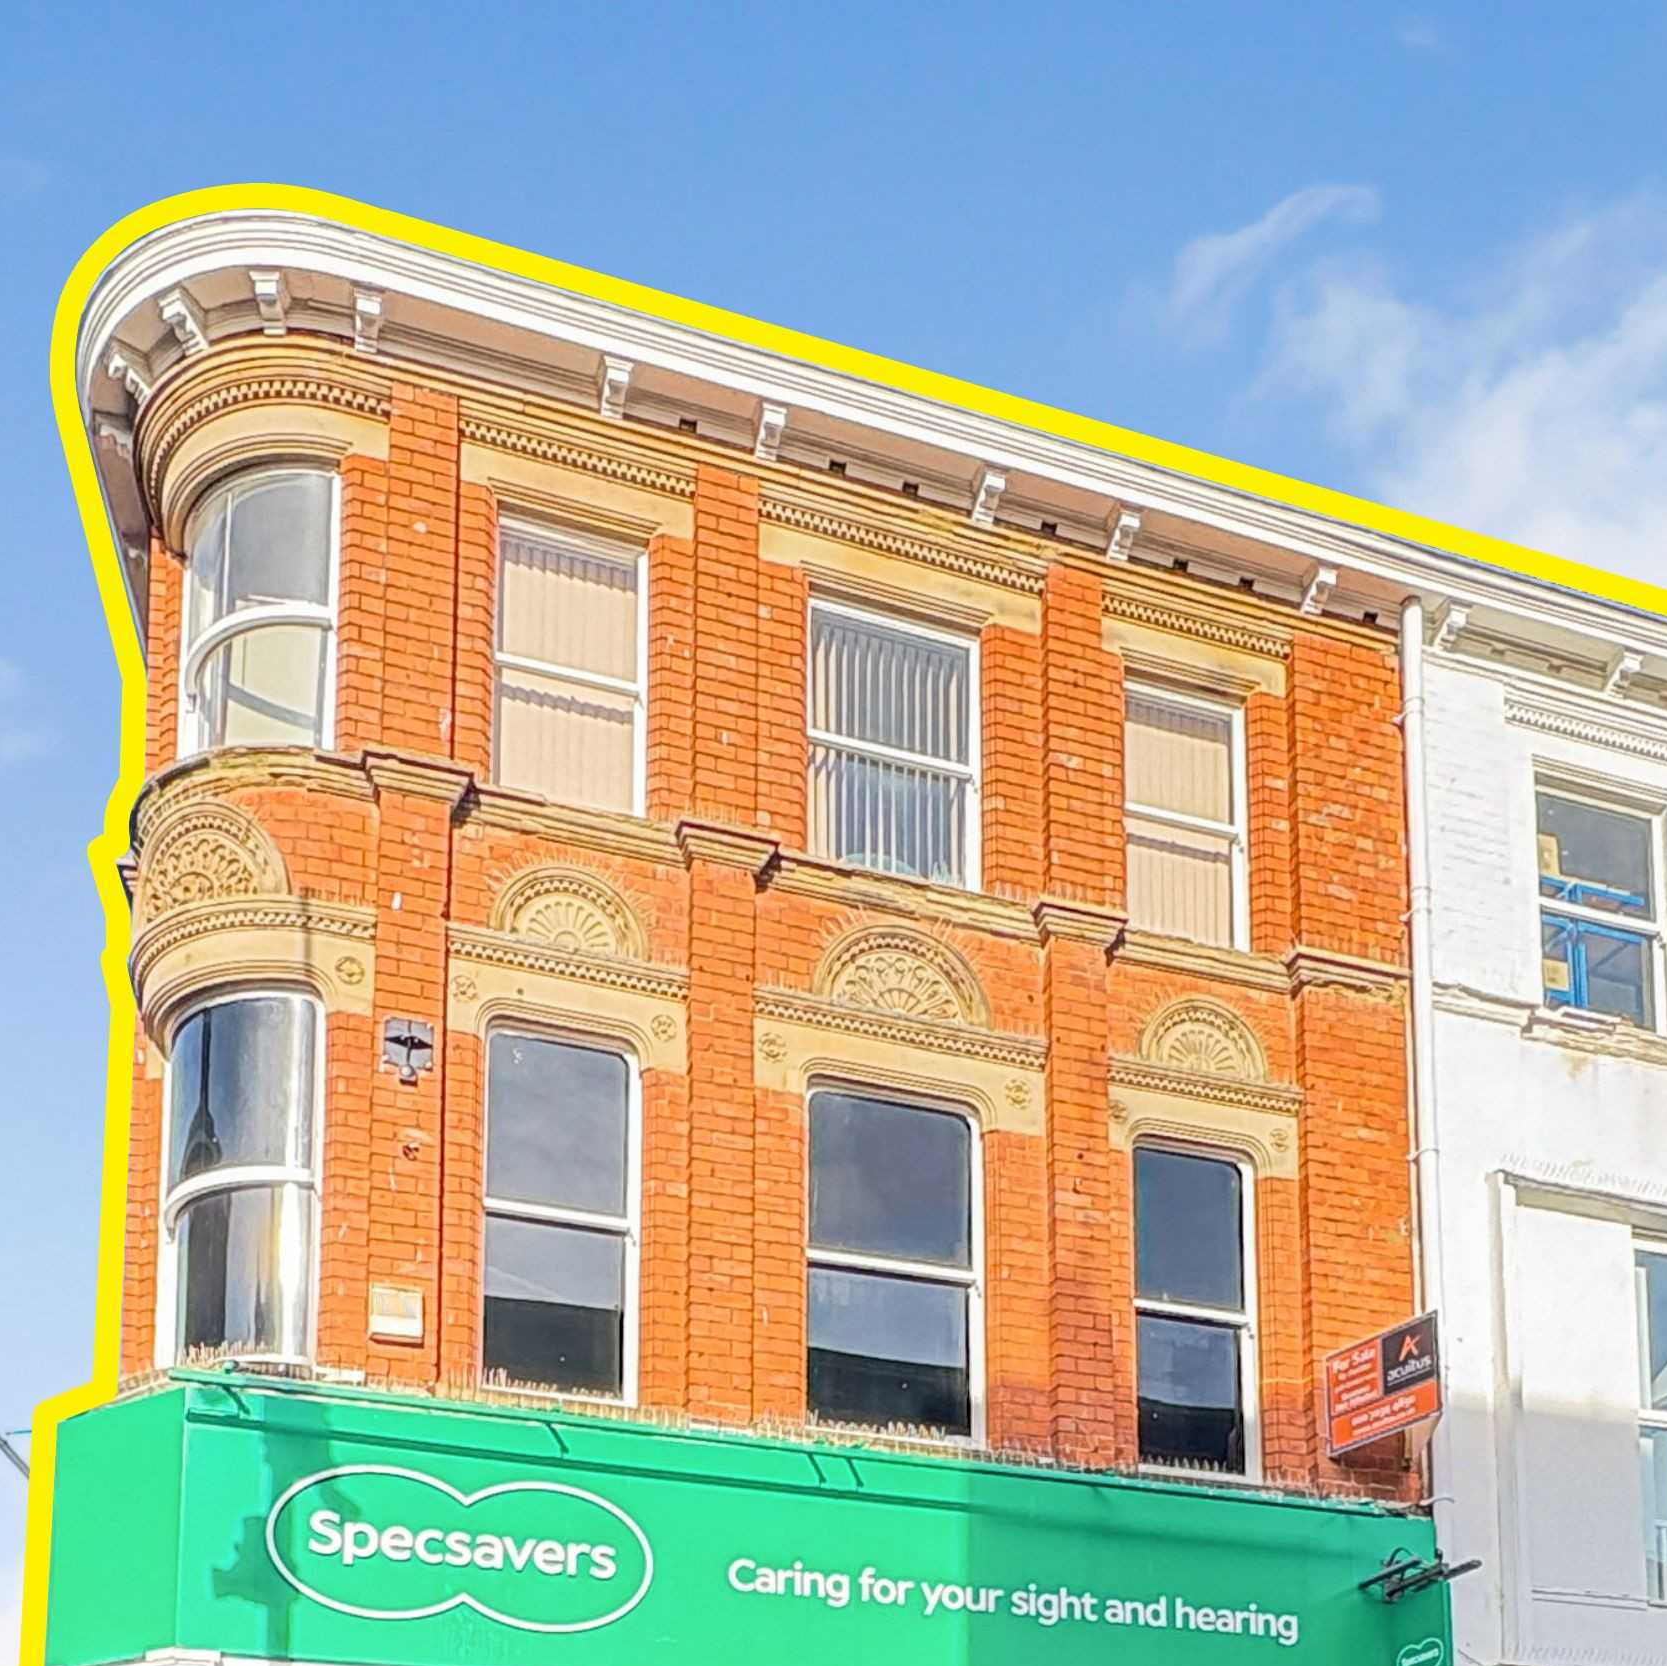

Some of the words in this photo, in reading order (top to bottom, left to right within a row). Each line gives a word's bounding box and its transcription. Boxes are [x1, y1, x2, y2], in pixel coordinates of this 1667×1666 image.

[307, 1509, 617, 1580] Specsavers
[727, 1558, 851, 1607] Caring
[857, 1566, 915, 1607] for
[920, 1578, 1005, 1616] your
[1010, 1583, 1099, 1627] sight
[1103, 1596, 1168, 1629] and
[1174, 1596, 1299, 1646] hearing
